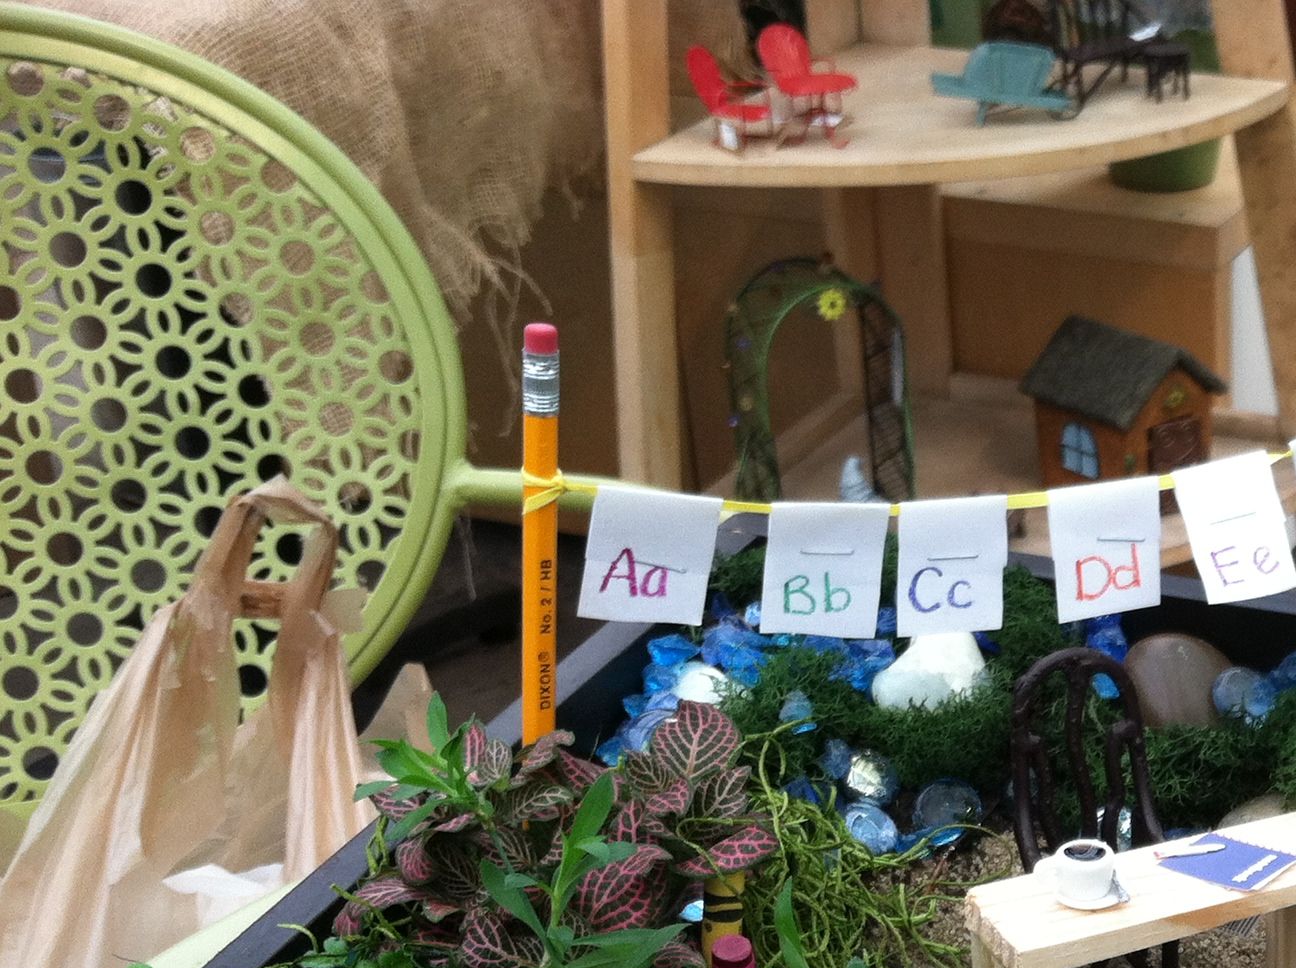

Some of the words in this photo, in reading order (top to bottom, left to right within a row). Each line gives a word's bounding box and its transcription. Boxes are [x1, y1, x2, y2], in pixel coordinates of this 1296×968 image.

[540, 559, 553, 581] HB
[599, 547, 670, 598] Aa
[1075, 543, 1142, 601] Dd
[1210, 546, 1280, 588] Ee
[783, 571, 852, 616] Bb
[908, 566, 974, 614] Cc
[540, 610, 553, 634] No.
